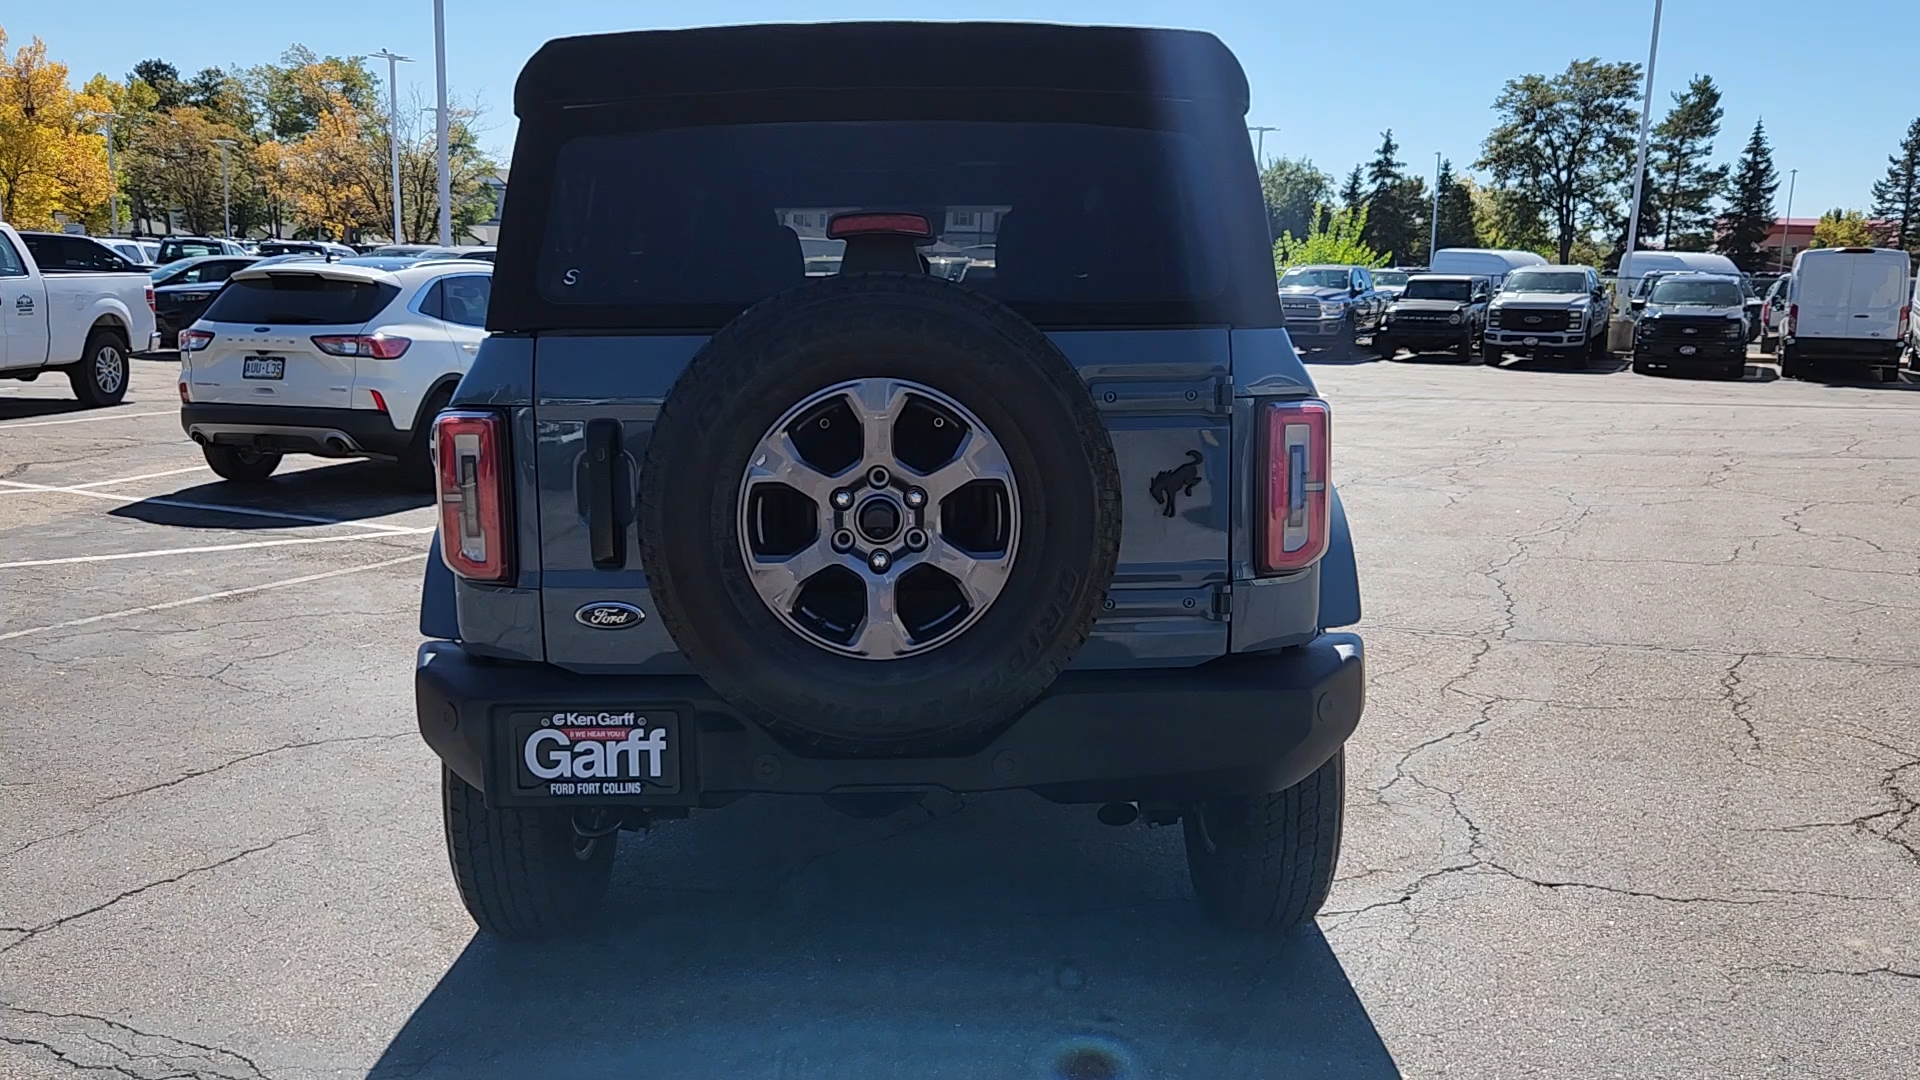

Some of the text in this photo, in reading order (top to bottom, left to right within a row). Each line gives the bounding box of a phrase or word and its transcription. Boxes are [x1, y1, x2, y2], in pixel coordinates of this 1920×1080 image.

[590, 608, 628, 623] Ford
[566, 712, 635, 725] Ken Garff
[575, 730, 620, 738] WE HEAR YOU
[524, 728, 667, 779] Garff
[550, 782, 642, 795] FORD FORT COLLINS
